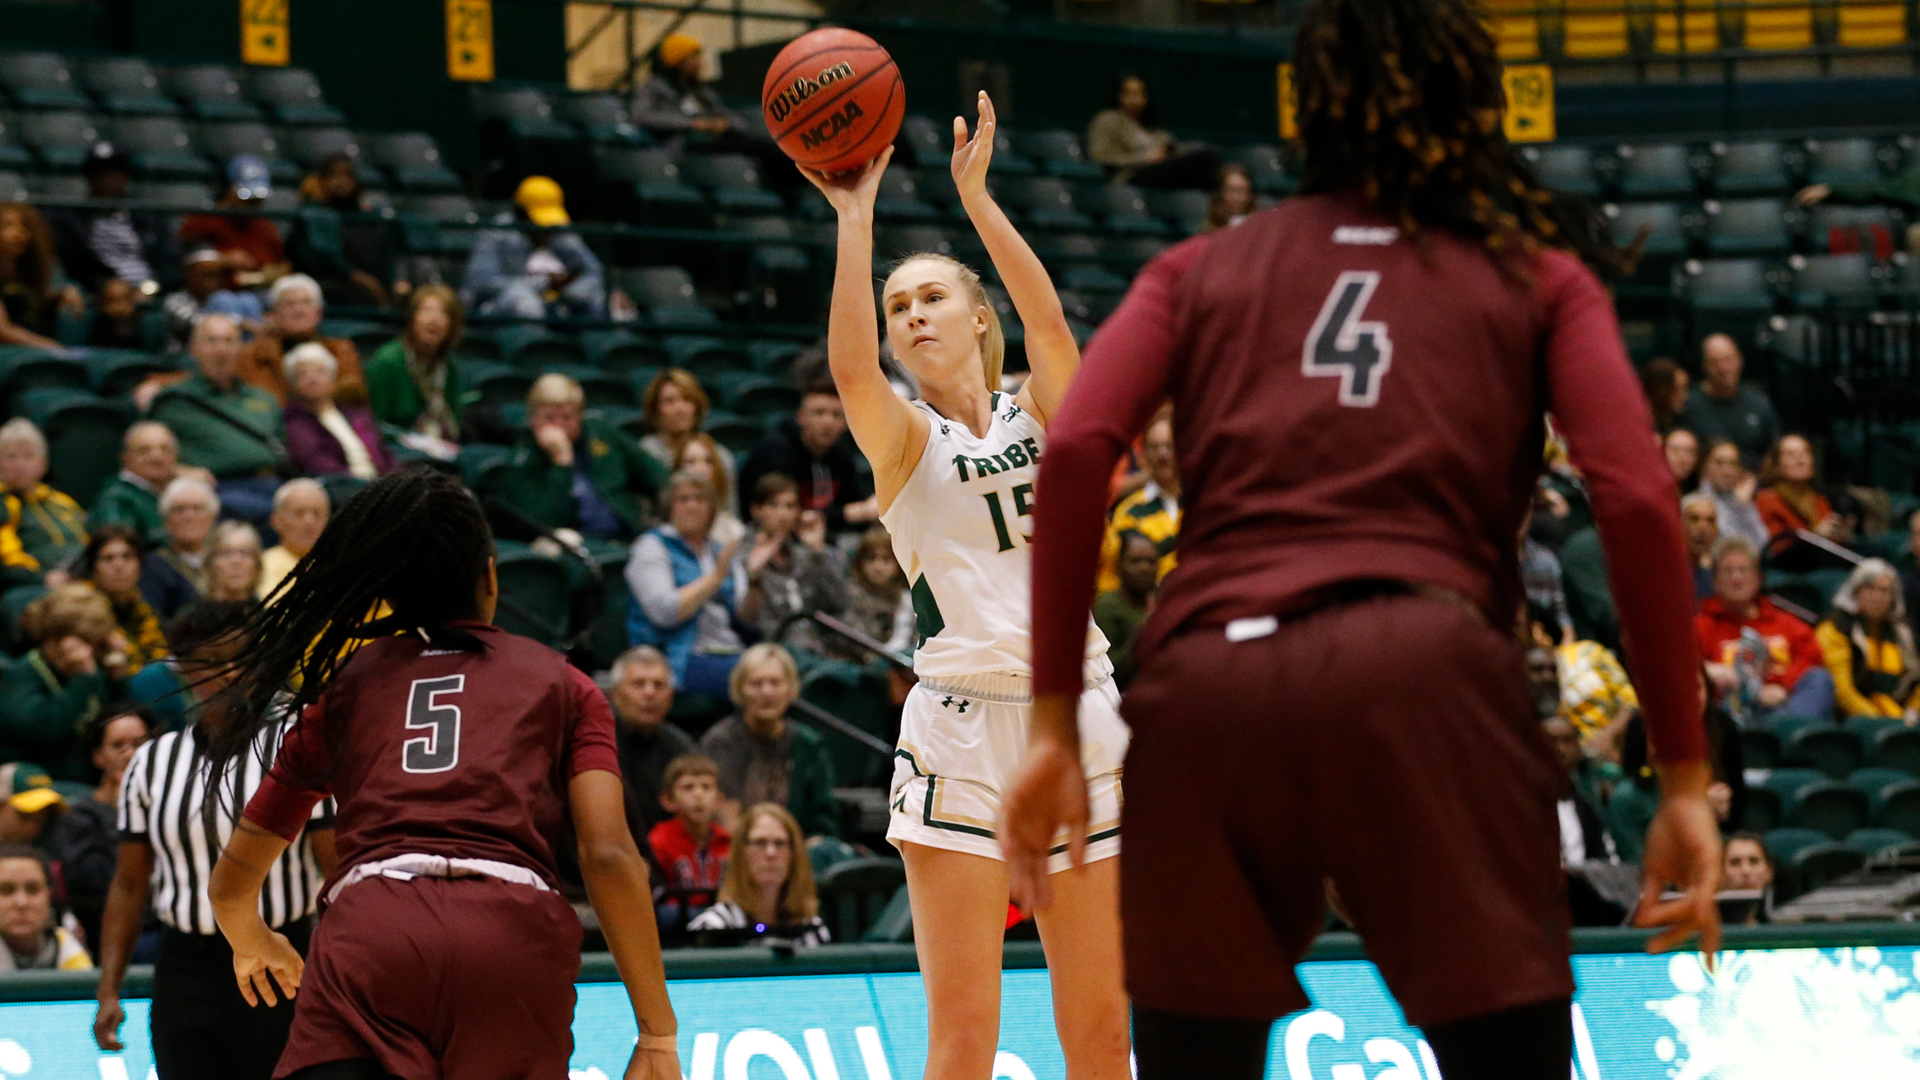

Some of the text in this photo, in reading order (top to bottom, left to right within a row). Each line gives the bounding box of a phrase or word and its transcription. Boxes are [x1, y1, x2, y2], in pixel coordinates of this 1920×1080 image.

[769, 61, 856, 123] Wilson
[800, 100, 864, 150] NCAA
[1301, 270, 1394, 409] 4
[952, 437, 1043, 483] TRIBE
[979, 482, 1037, 554] 15
[402, 674, 465, 774] 5
